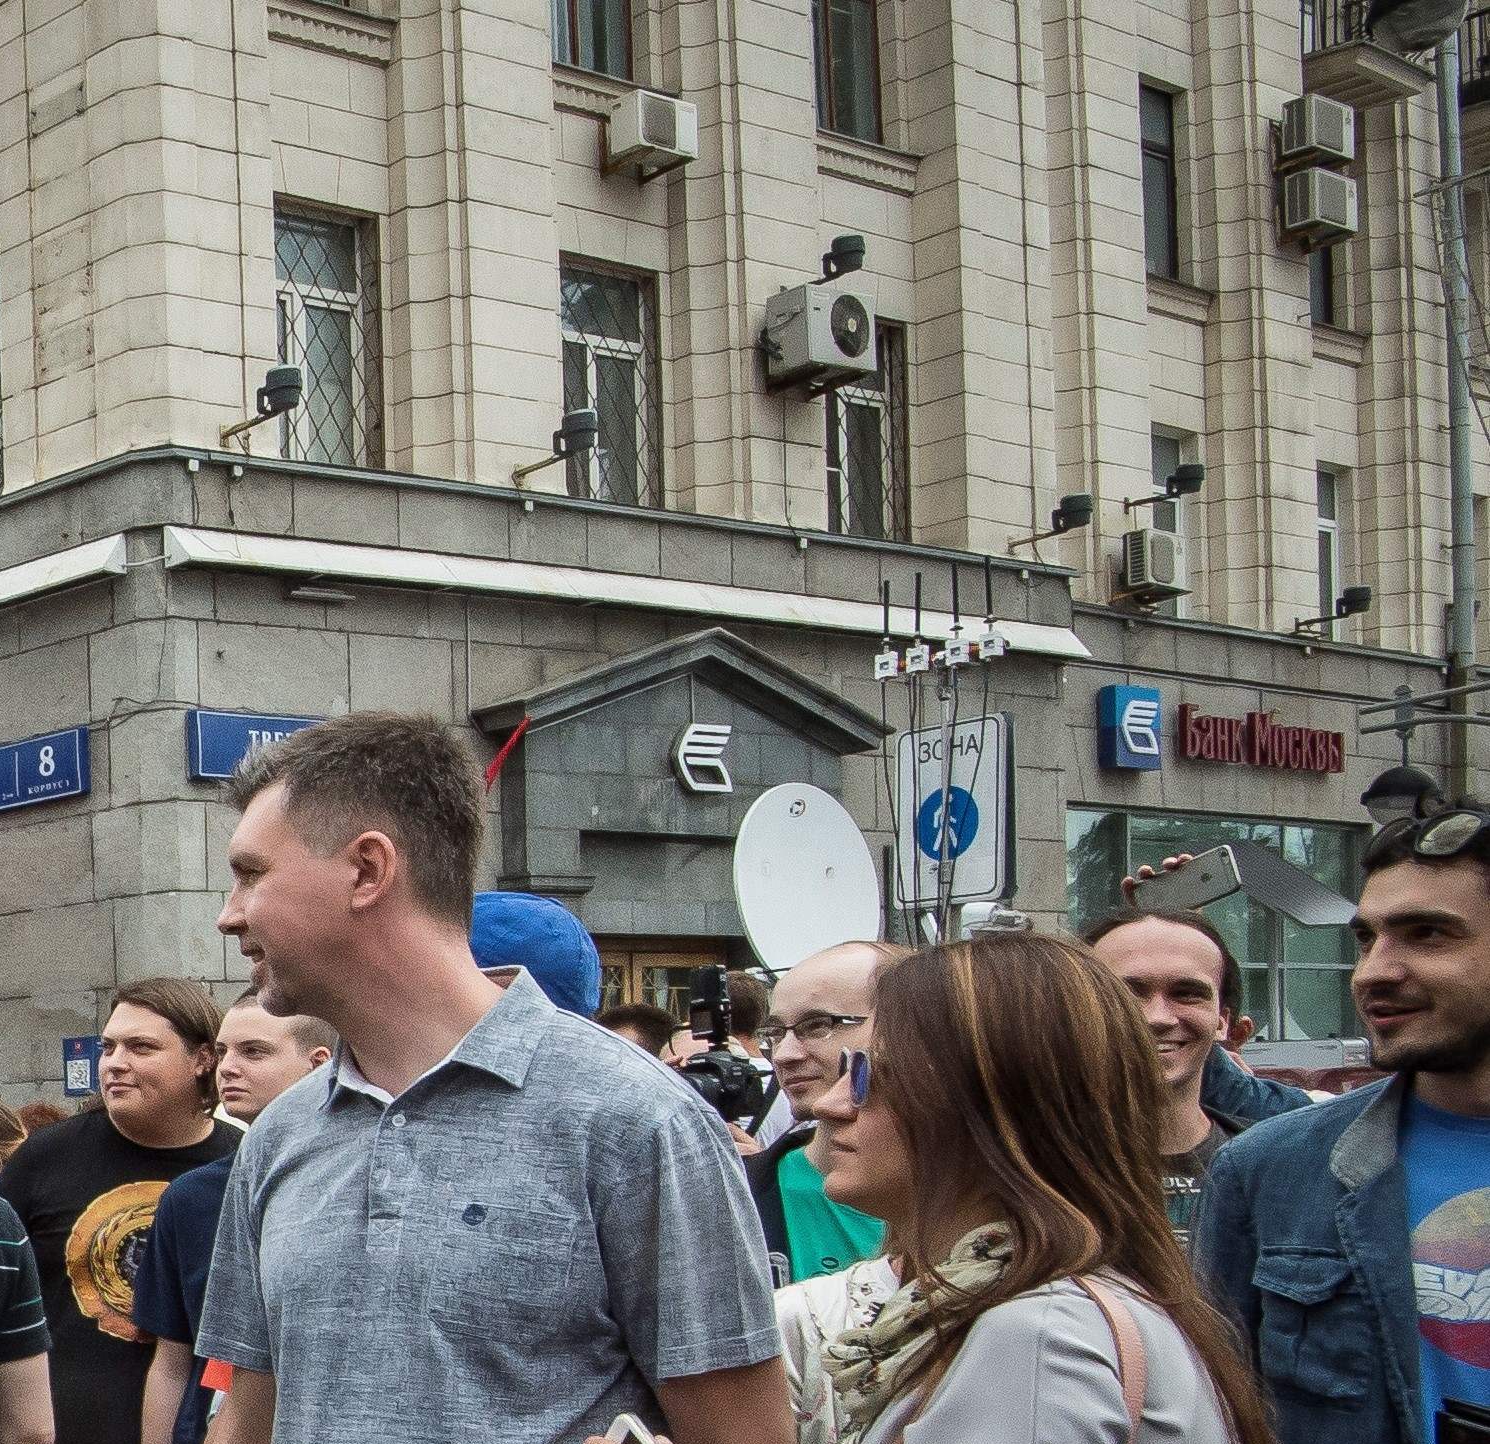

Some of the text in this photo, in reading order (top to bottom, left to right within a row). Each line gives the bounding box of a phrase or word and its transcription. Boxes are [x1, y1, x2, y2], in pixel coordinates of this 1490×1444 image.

[918, 733, 981, 764] ЗОНА
[1178, 702, 1346, 774] Банк Москвы
[38, 745, 55, 777] 8
[27, 780, 63, 795] КОРПУС
